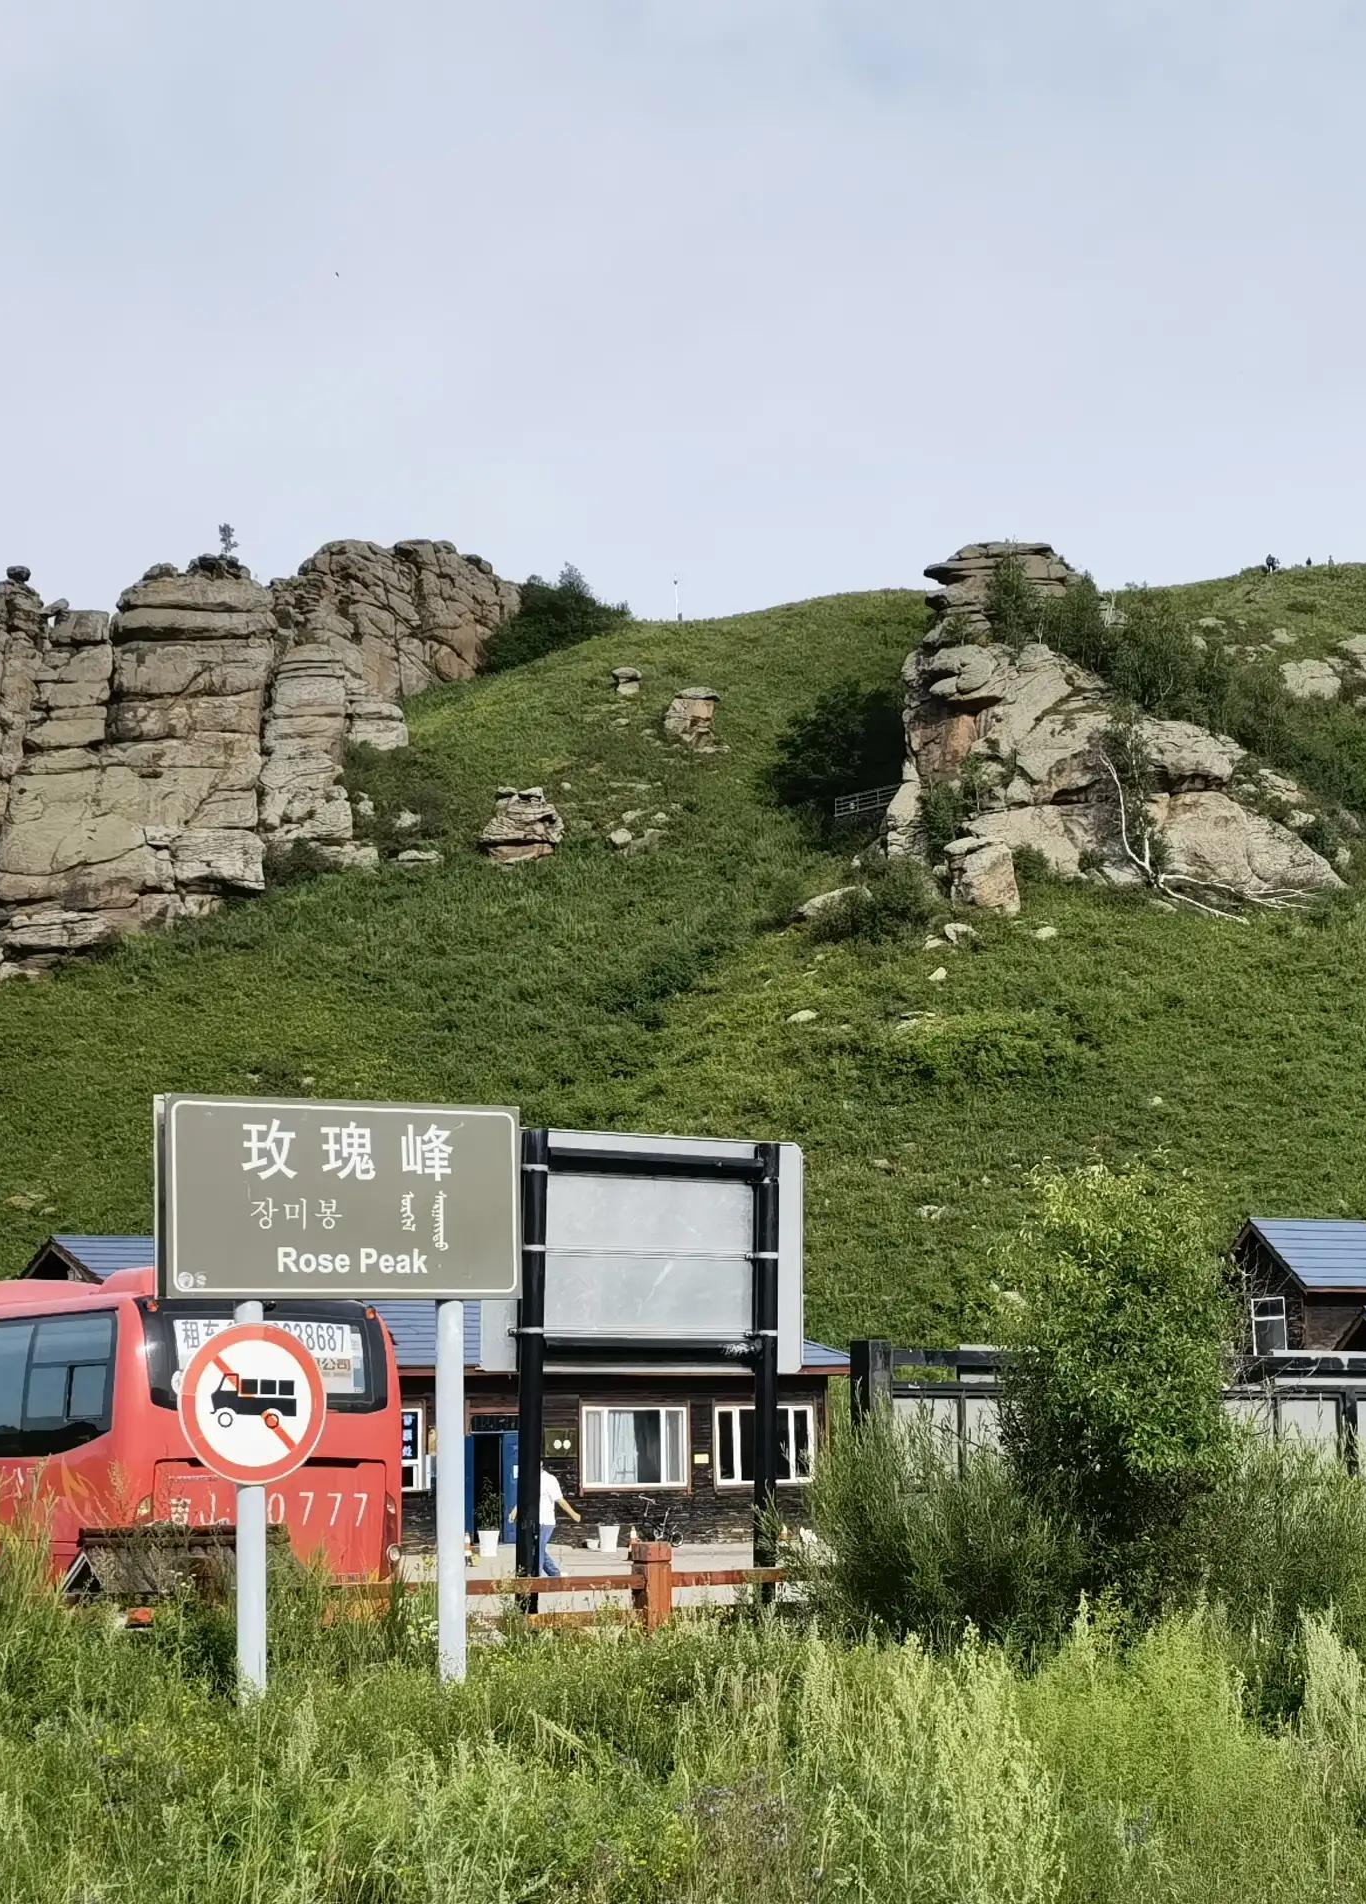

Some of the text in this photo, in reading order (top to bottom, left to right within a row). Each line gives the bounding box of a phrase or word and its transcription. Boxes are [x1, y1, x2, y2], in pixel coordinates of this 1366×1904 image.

[241, 1118, 454, 1181] 玫瑰峰
[250, 1197, 343, 1230] 장미봉
[277, 1246, 428, 1274] Rose Peak
